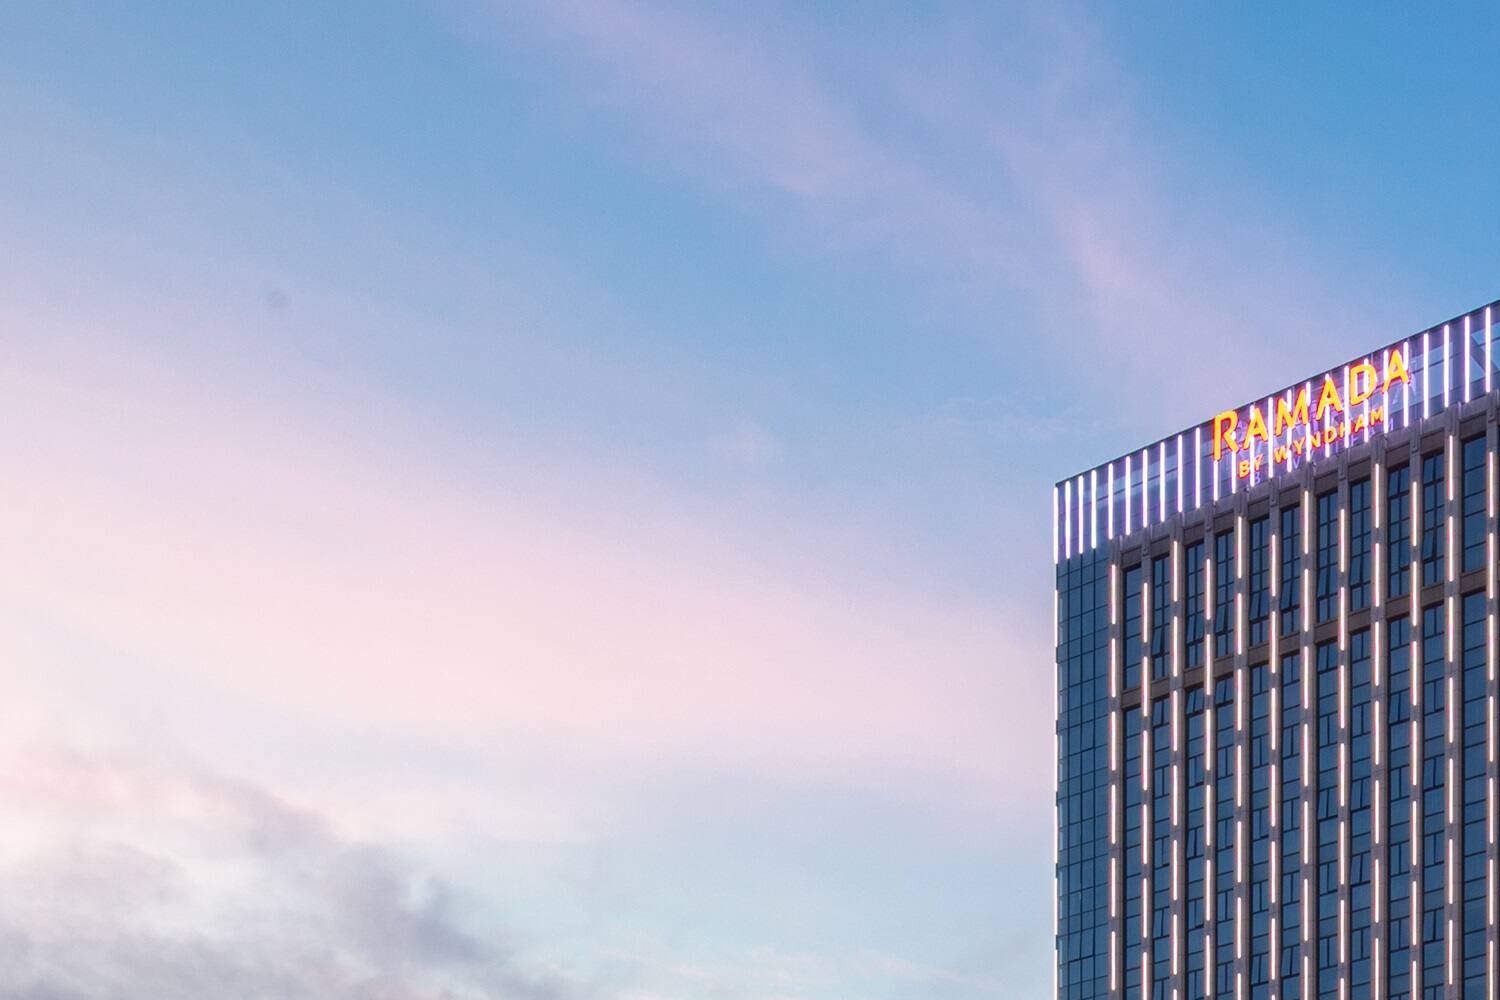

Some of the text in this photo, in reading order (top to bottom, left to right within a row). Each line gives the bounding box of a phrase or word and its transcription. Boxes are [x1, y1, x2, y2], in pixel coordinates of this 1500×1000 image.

[1212, 349, 1410, 461] RAMADA
[1238, 405, 1385, 479] BY WYNDHAM
